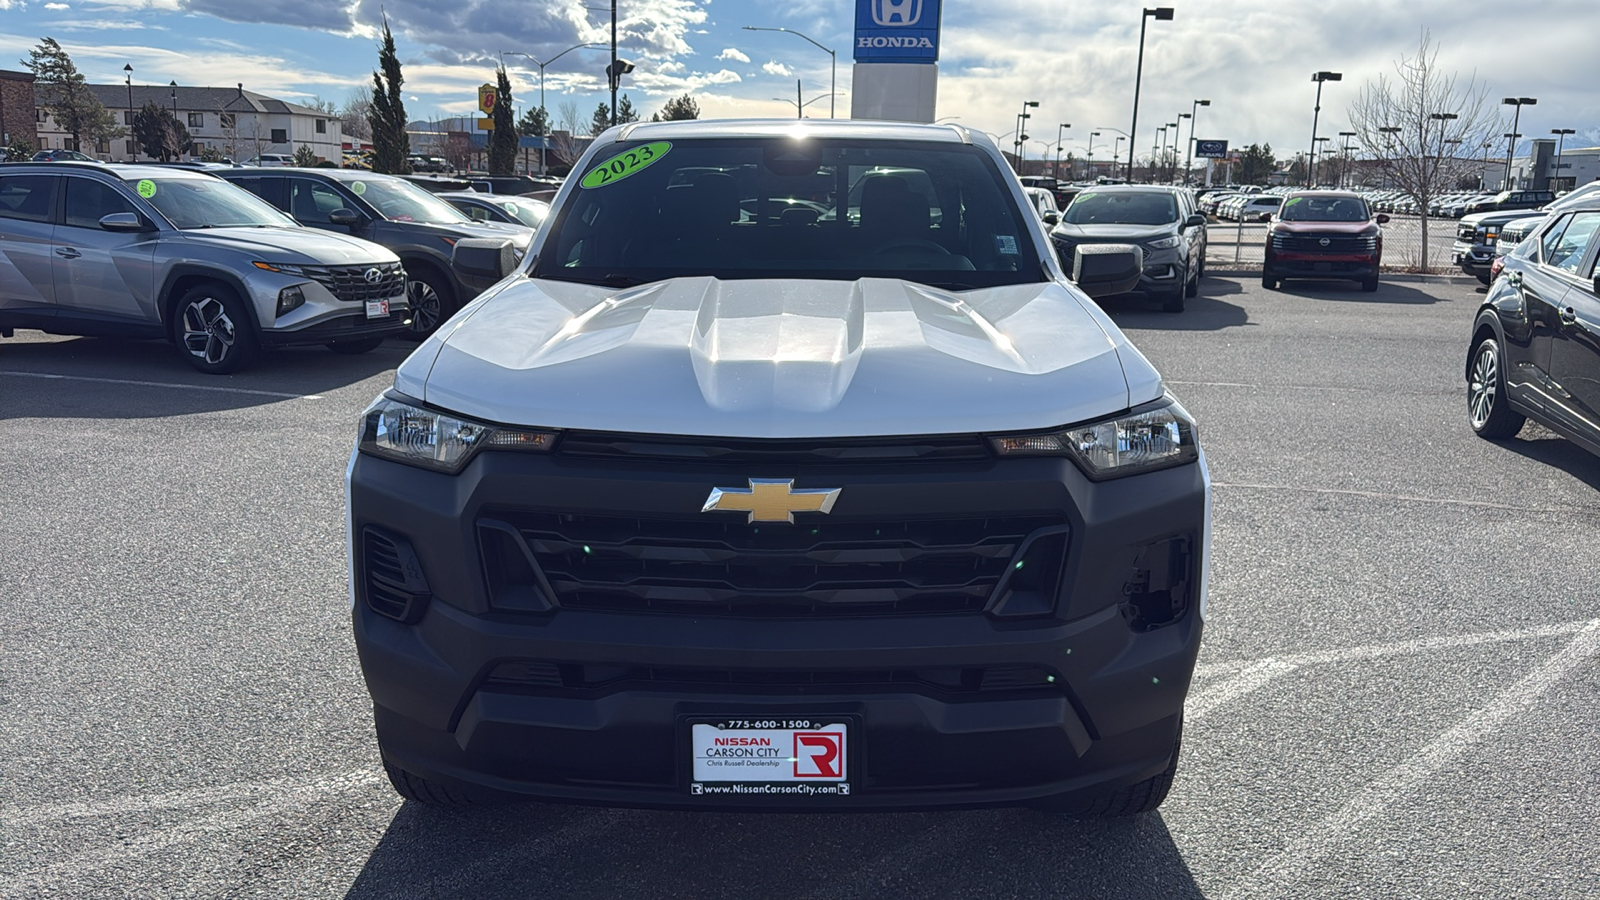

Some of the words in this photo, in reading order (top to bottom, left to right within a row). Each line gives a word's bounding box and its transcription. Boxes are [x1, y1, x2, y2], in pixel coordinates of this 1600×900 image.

[857, 37, 934, 48] HONDA
[483, 93, 494, 108] 8
[596, 146, 654, 183] 2023
[728, 720, 810, 728] 775-600-1500
[714, 737, 770, 746] NISSAN
[706, 748, 753, 757] CARSON
[756, 748, 780, 757] CITY
[746, 760, 780, 768] Dealership
[704, 783, 837, 795] www.NissanCarsonCity.com
